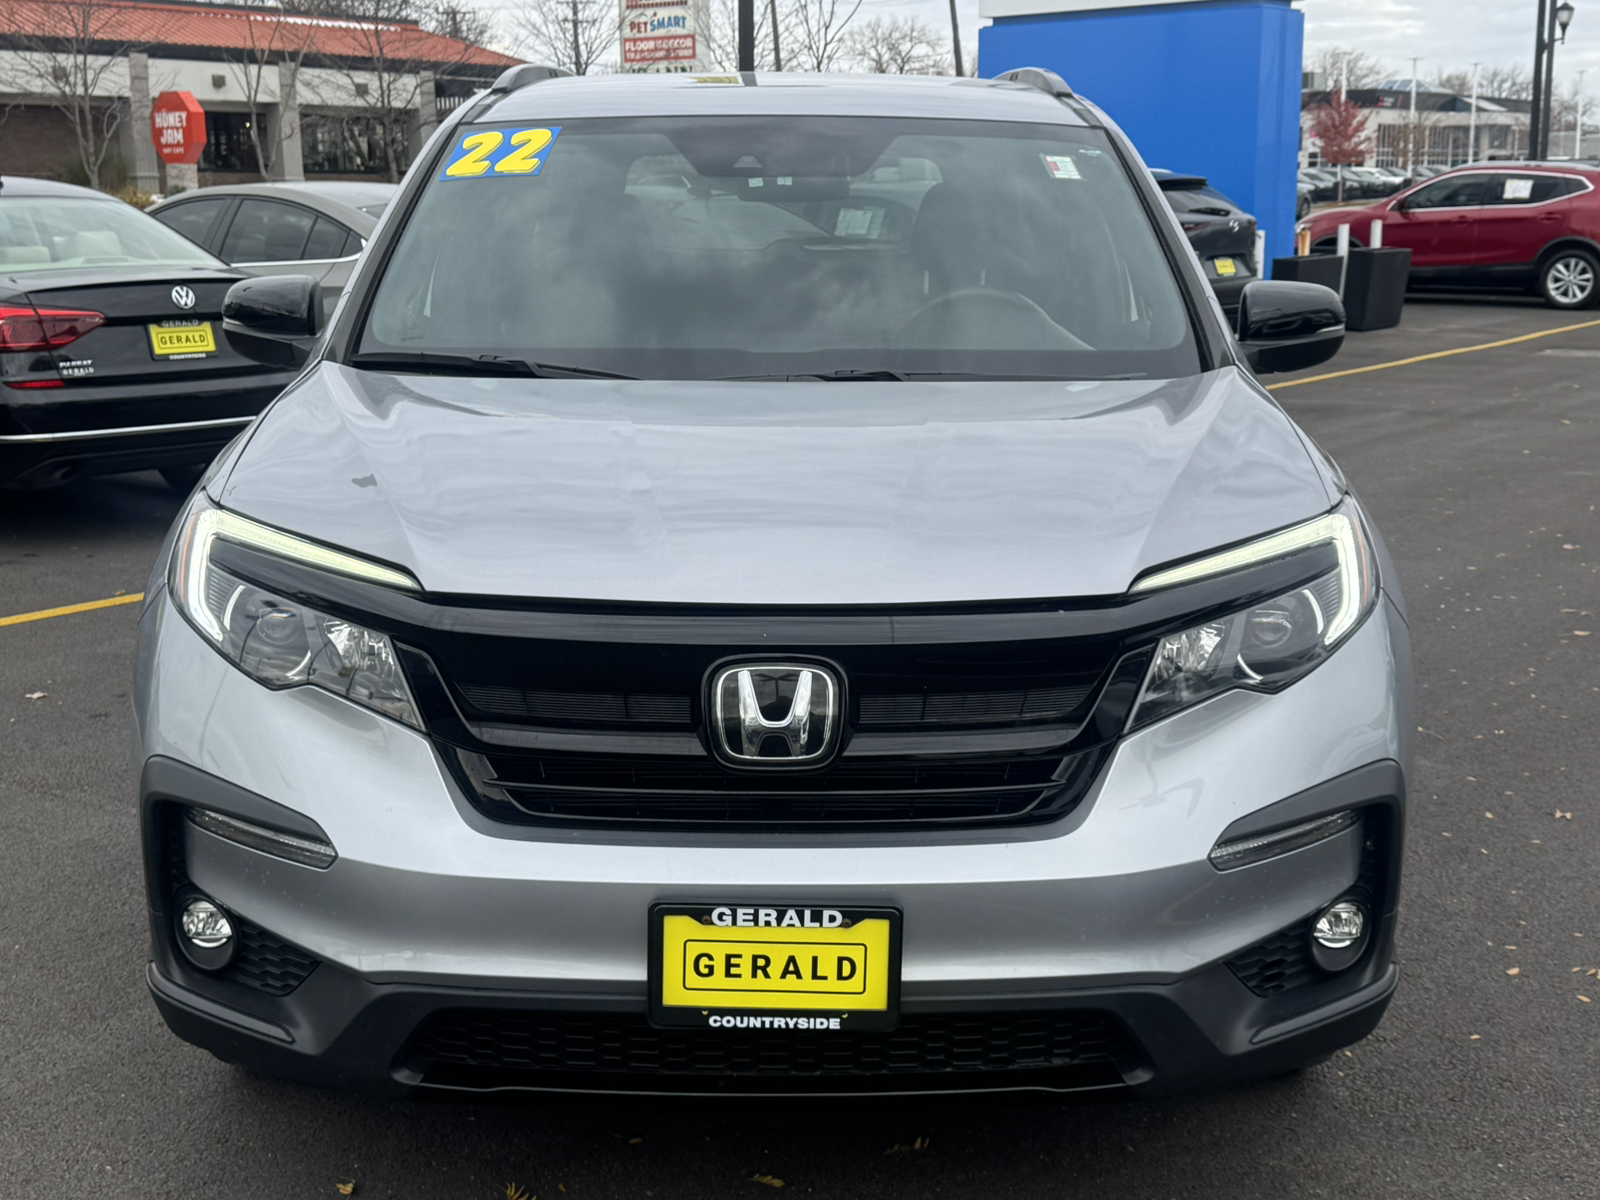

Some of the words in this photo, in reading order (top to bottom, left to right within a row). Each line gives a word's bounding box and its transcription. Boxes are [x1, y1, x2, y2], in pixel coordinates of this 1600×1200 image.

[626, 41, 655, 50] FLOOR
[154, 111, 187, 128] HONEY
[160, 129, 184, 145] JAM
[445, 128, 553, 177] 22
[162, 319, 199, 328] GERALD
[159, 334, 206, 346] GERALD
[711, 907, 844, 929] GERALD
[692, 952, 858, 981] GERALD
[708, 1015, 841, 1030] COUNTRYSIDE
